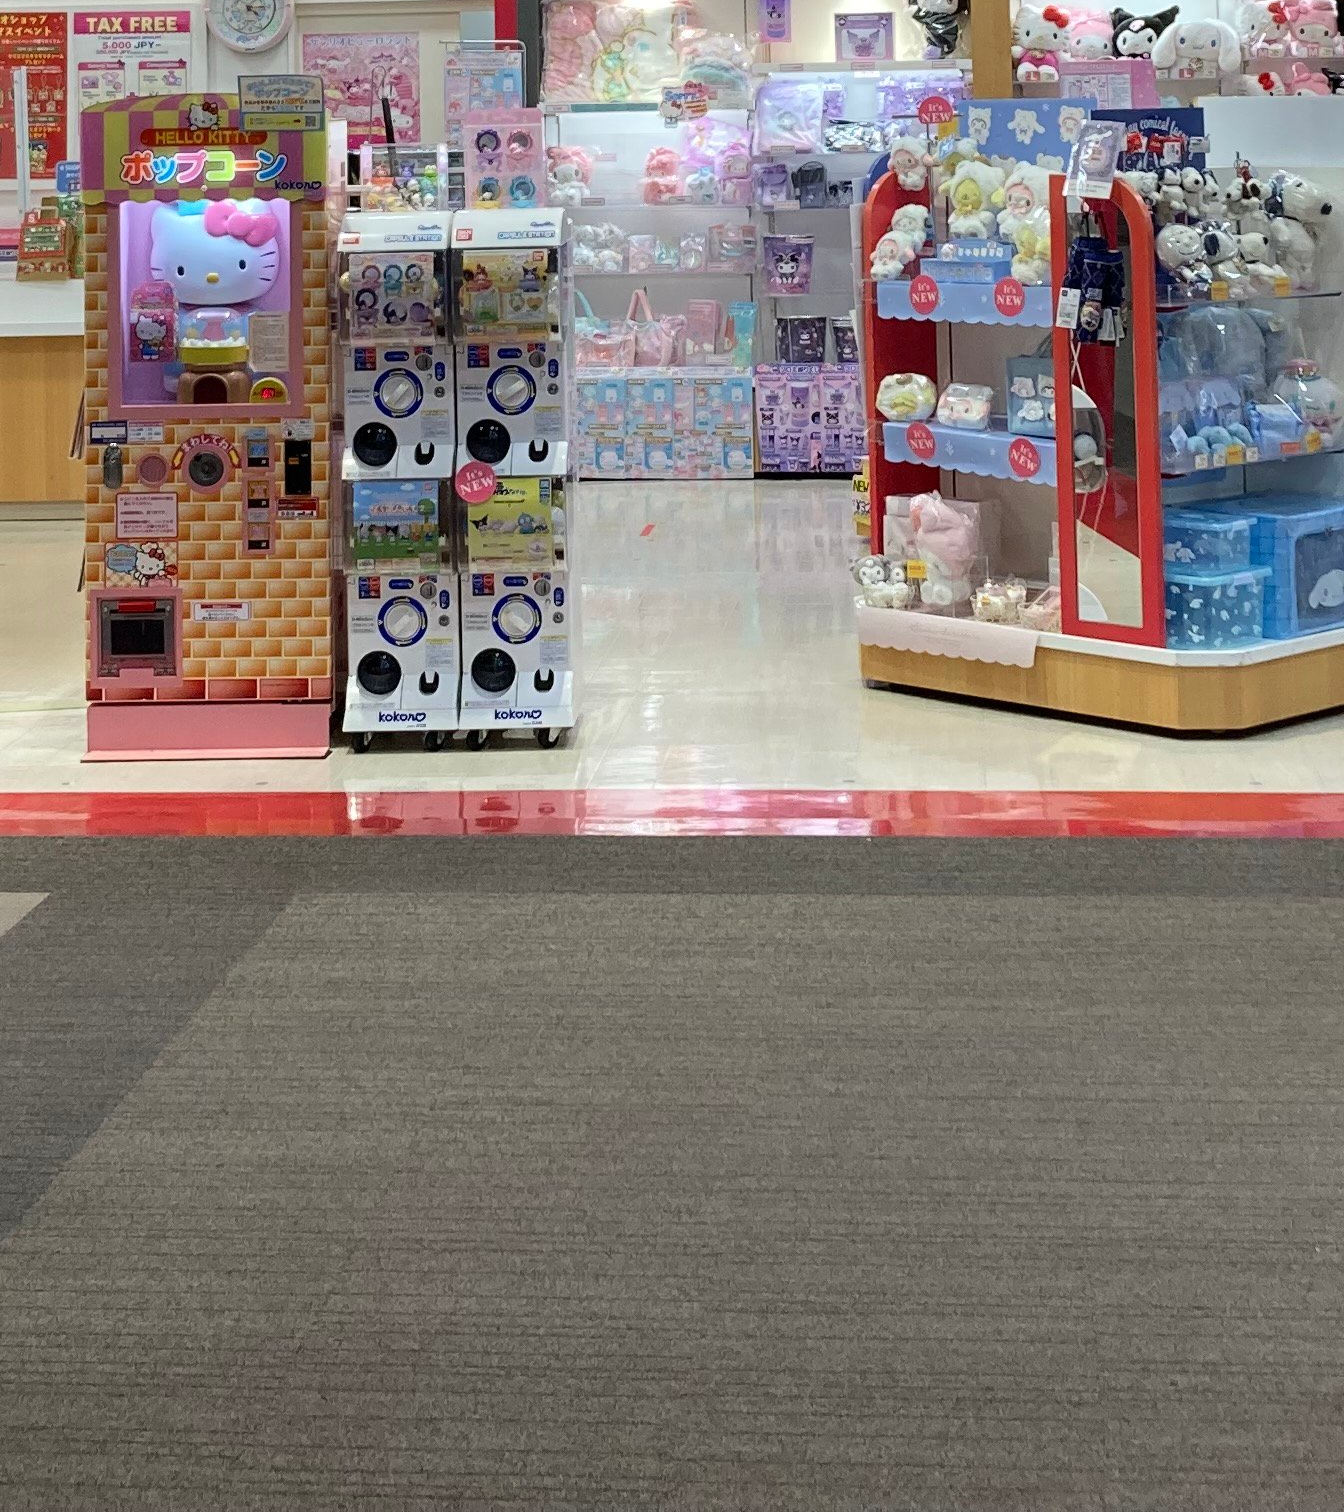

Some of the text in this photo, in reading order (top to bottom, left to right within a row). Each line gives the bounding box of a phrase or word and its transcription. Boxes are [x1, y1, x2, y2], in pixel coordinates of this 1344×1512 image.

[86, 16, 178, 33] TAX FREE
[928, 103, 943, 112] It's
[921, 112, 951, 123] NEW
[155, 130, 253, 144] HELLO KITTY
[120, 149, 288, 185] ポップコーン
[27, 214, 35, 223] S
[918, 282, 930, 291] It's
[1003, 285, 1016, 294] It's
[912, 291, 937, 303] NEW
[996, 294, 1023, 306] NEW
[913, 429, 926, 438] It's
[909, 438, 934, 450] NEW
[1010, 449, 1037, 472] NEW
[466, 469, 484, 479] It's
[459, 476, 495, 495] NEW
[378, 711, 427, 723] kokoro
[494, 708, 543, 720] kokoro
